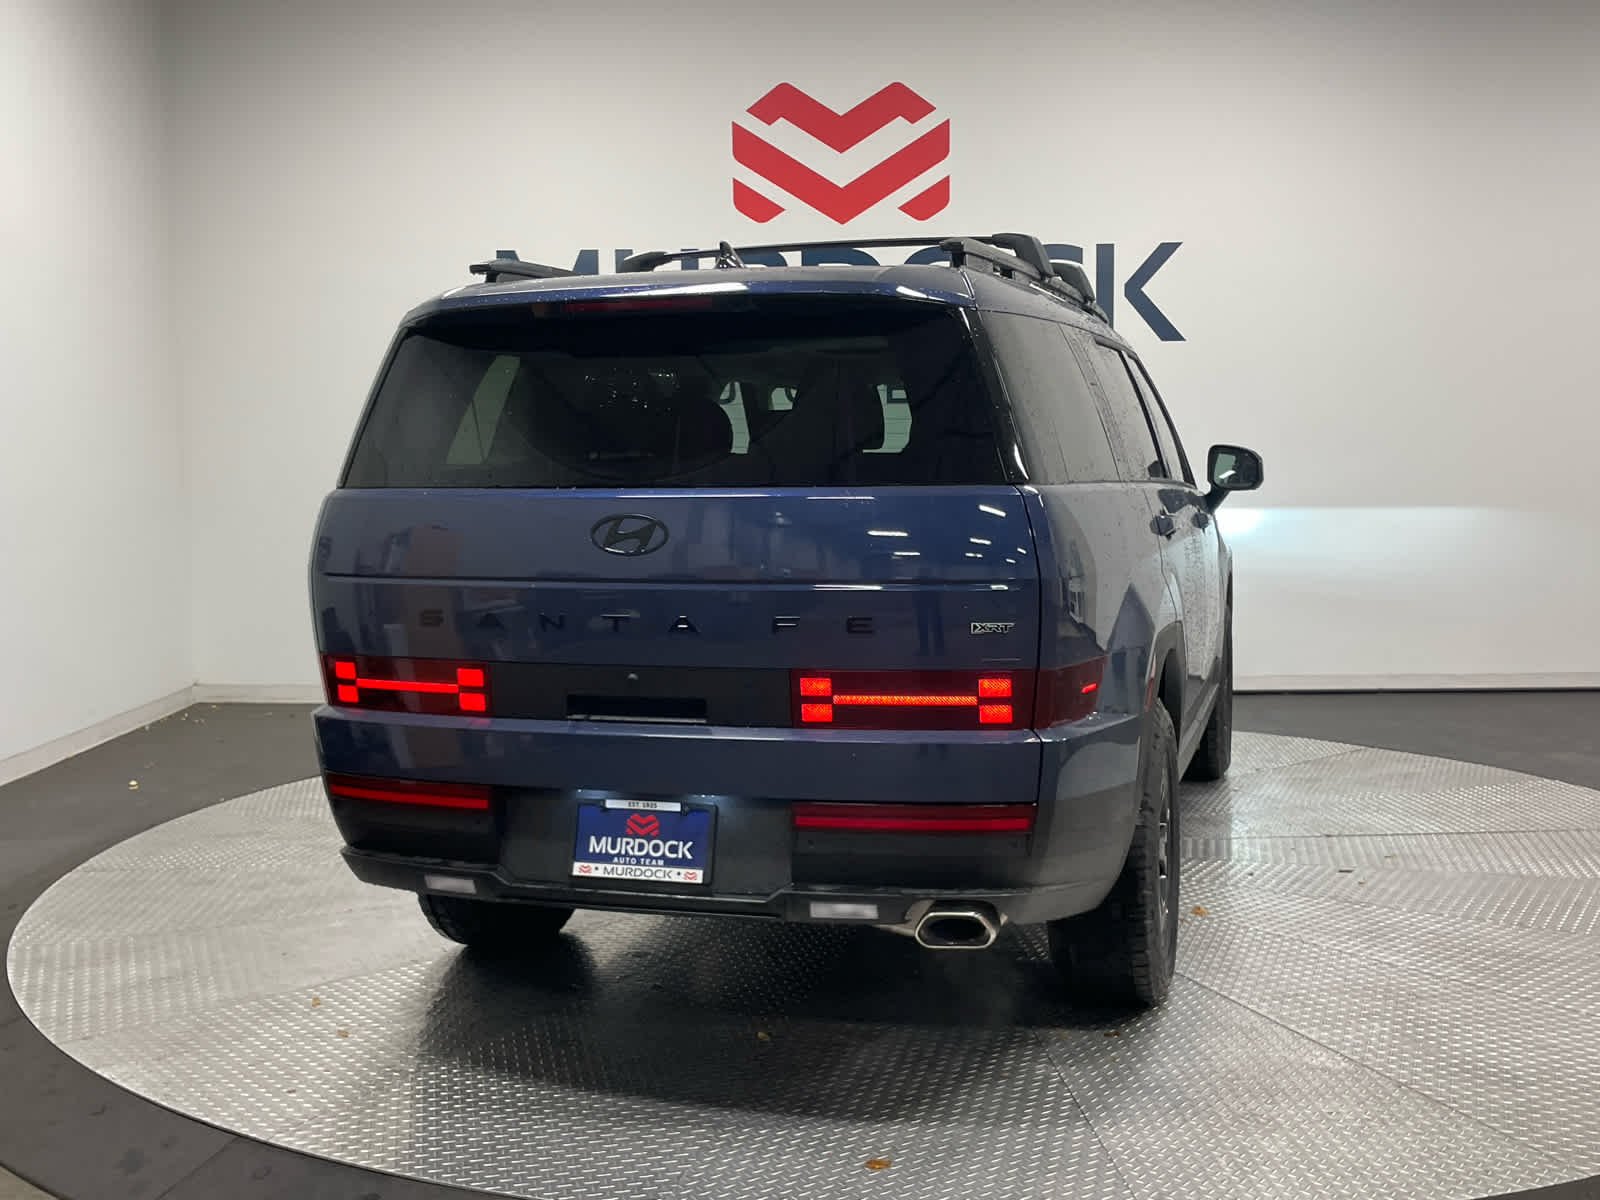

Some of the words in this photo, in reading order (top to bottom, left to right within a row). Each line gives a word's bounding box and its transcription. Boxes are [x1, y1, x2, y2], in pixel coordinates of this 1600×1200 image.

[418, 609, 699, 634] SANTA
[772, 615, 875, 634] FE
[970, 622, 1016, 635] XRT
[589, 836, 693, 859] MURDOCK
[613, 857, 637, 865] AUTO
[641, 858, 664, 866] TEAM
[603, 866, 672, 879] MURDOCK
